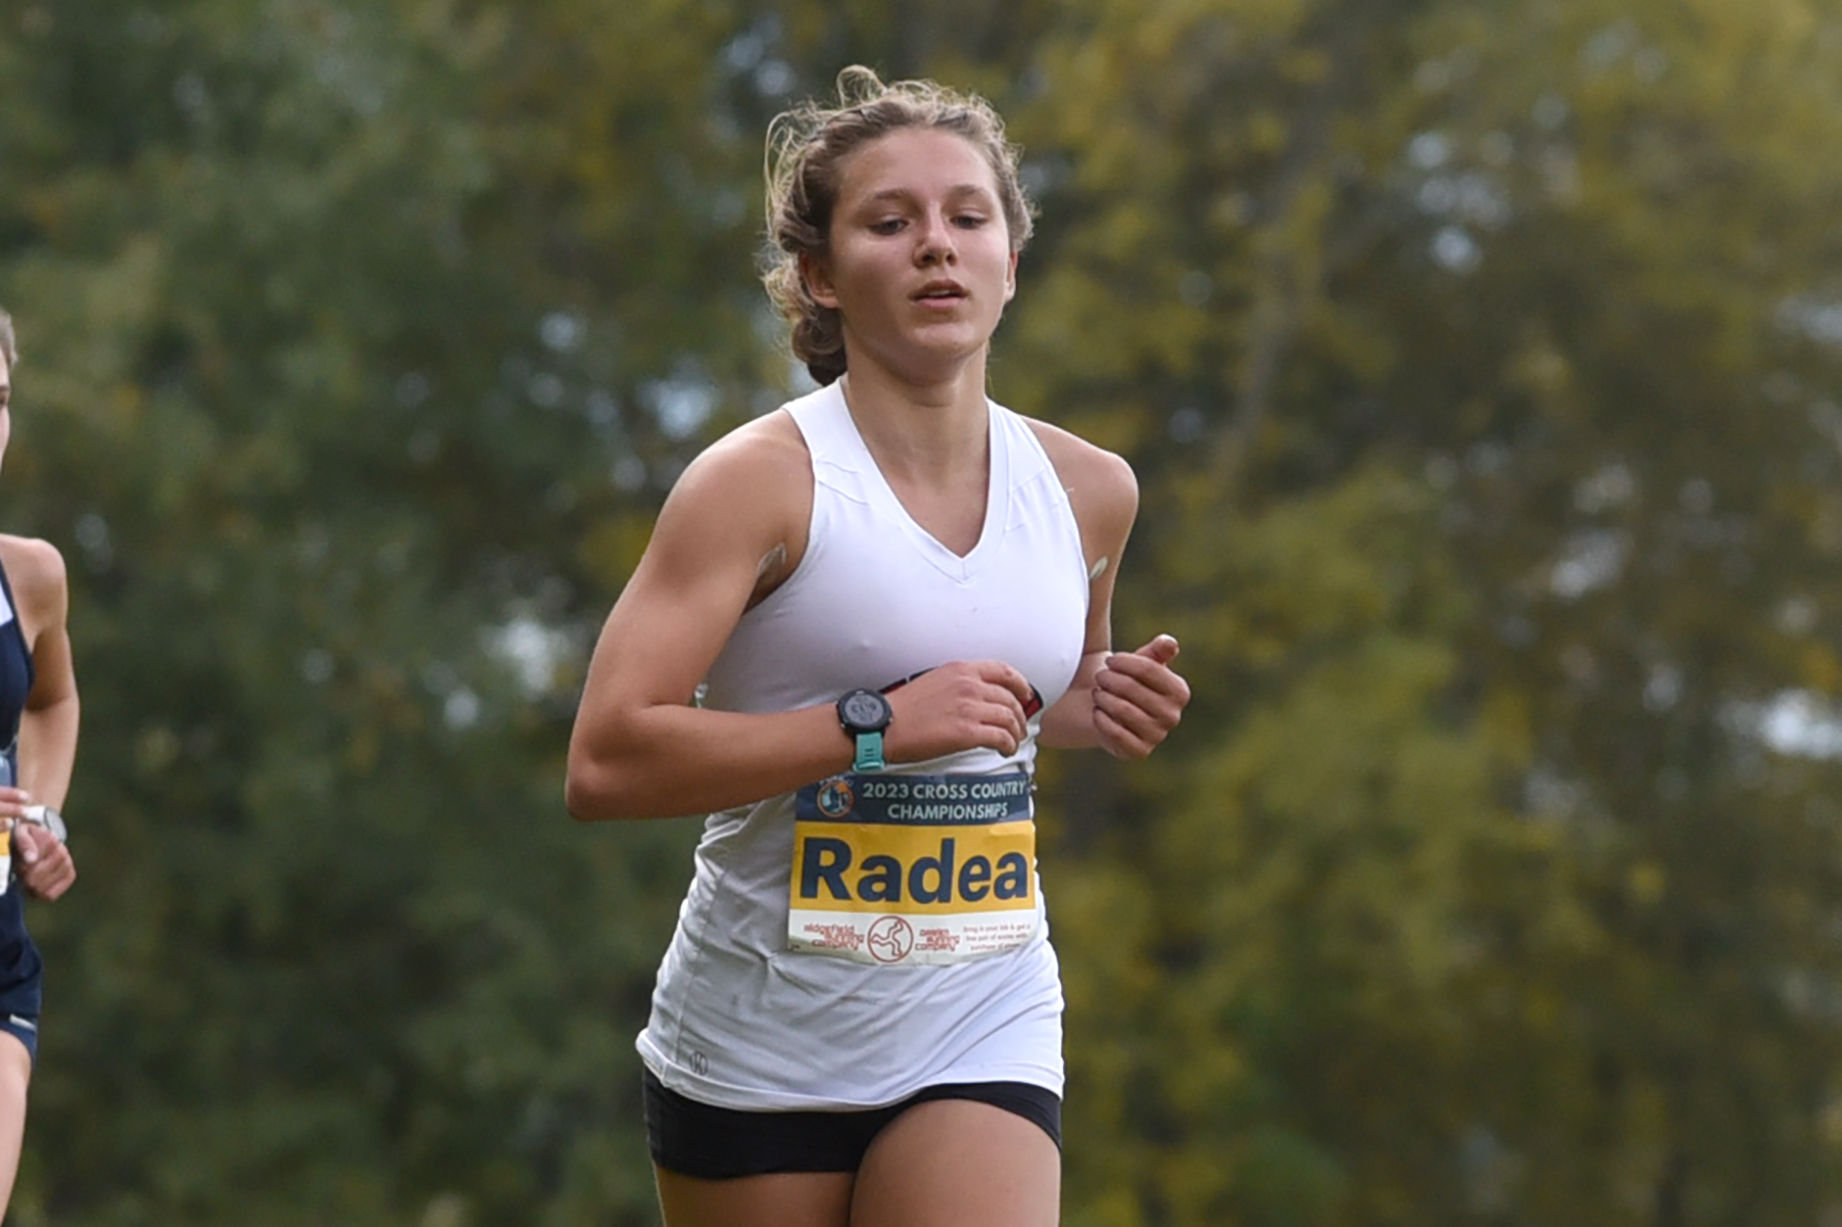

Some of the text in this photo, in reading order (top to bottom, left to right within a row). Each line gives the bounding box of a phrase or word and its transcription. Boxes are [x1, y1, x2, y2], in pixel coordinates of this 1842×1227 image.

[863, 780, 1026, 800] 2023 CROSS COUNTRY
[887, 802, 1008, 820] CHAMPIONSHIPS
[800, 837, 1028, 905] Radea
